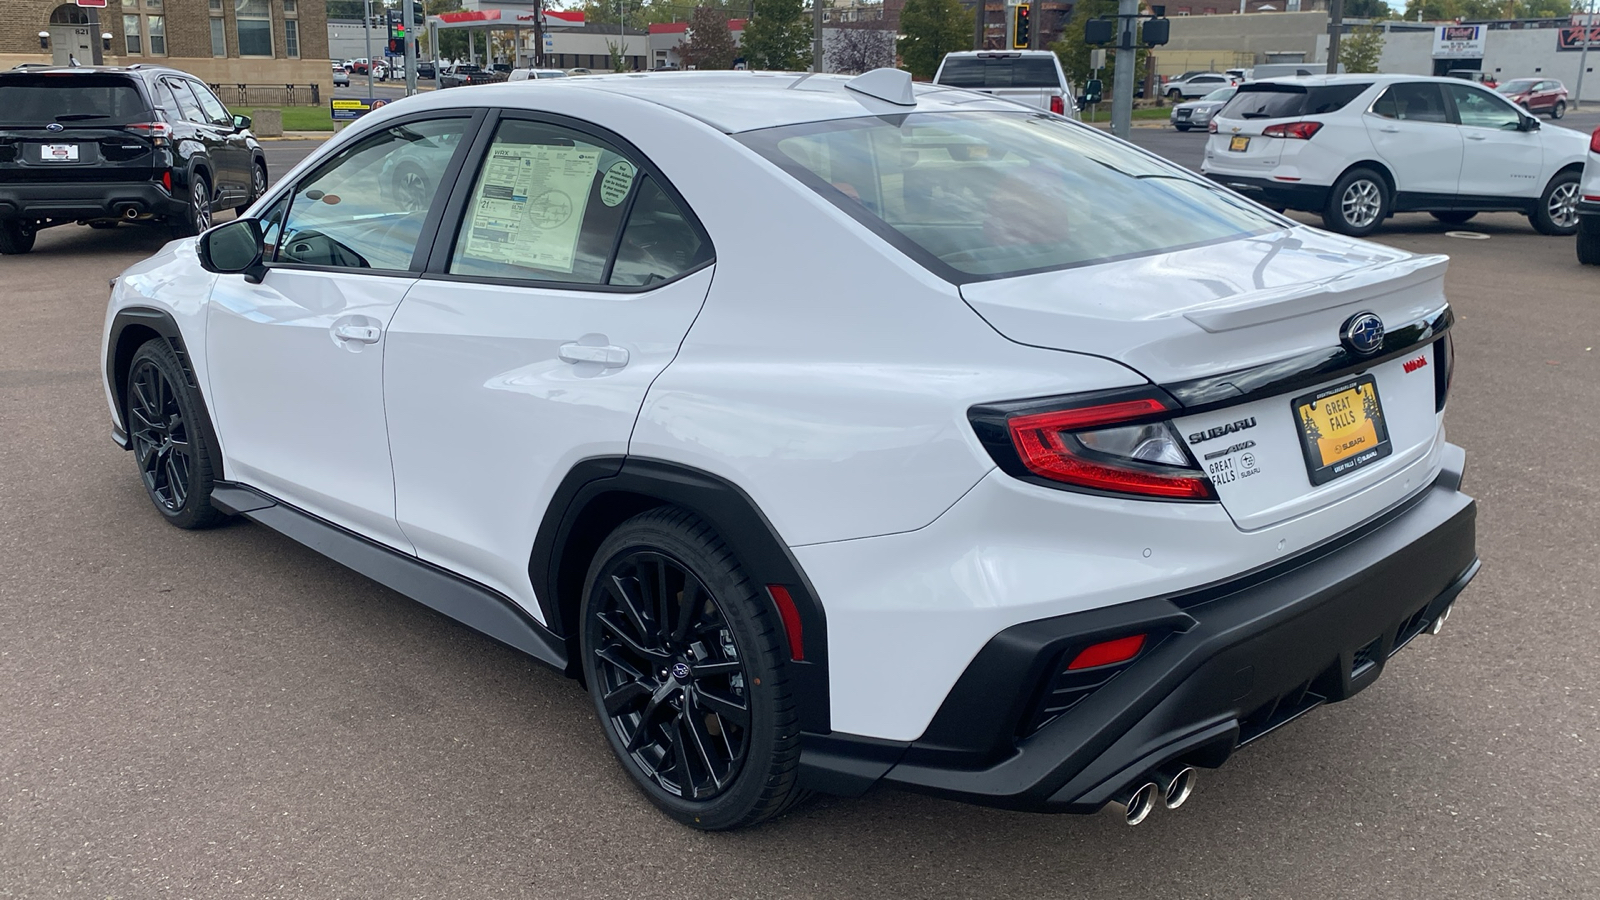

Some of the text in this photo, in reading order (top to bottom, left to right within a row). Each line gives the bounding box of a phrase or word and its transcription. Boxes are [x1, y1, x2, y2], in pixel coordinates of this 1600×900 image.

[481, 200, 489, 209] 21
[1325, 396, 1351, 416] GREAT
[1329, 410, 1356, 431] FALLS
[1188, 416, 1257, 445] SUBARU
[1226, 440, 1257, 455] AWD
[1341, 436, 1365, 450] SUBARU
[1209, 457, 1232, 474] GREAT
[1333, 450, 1378, 473] GREAT FALLS SUBARU
[1211, 470, 1236, 486] FALLS
[1240, 467, 1261, 479] SUBARU
